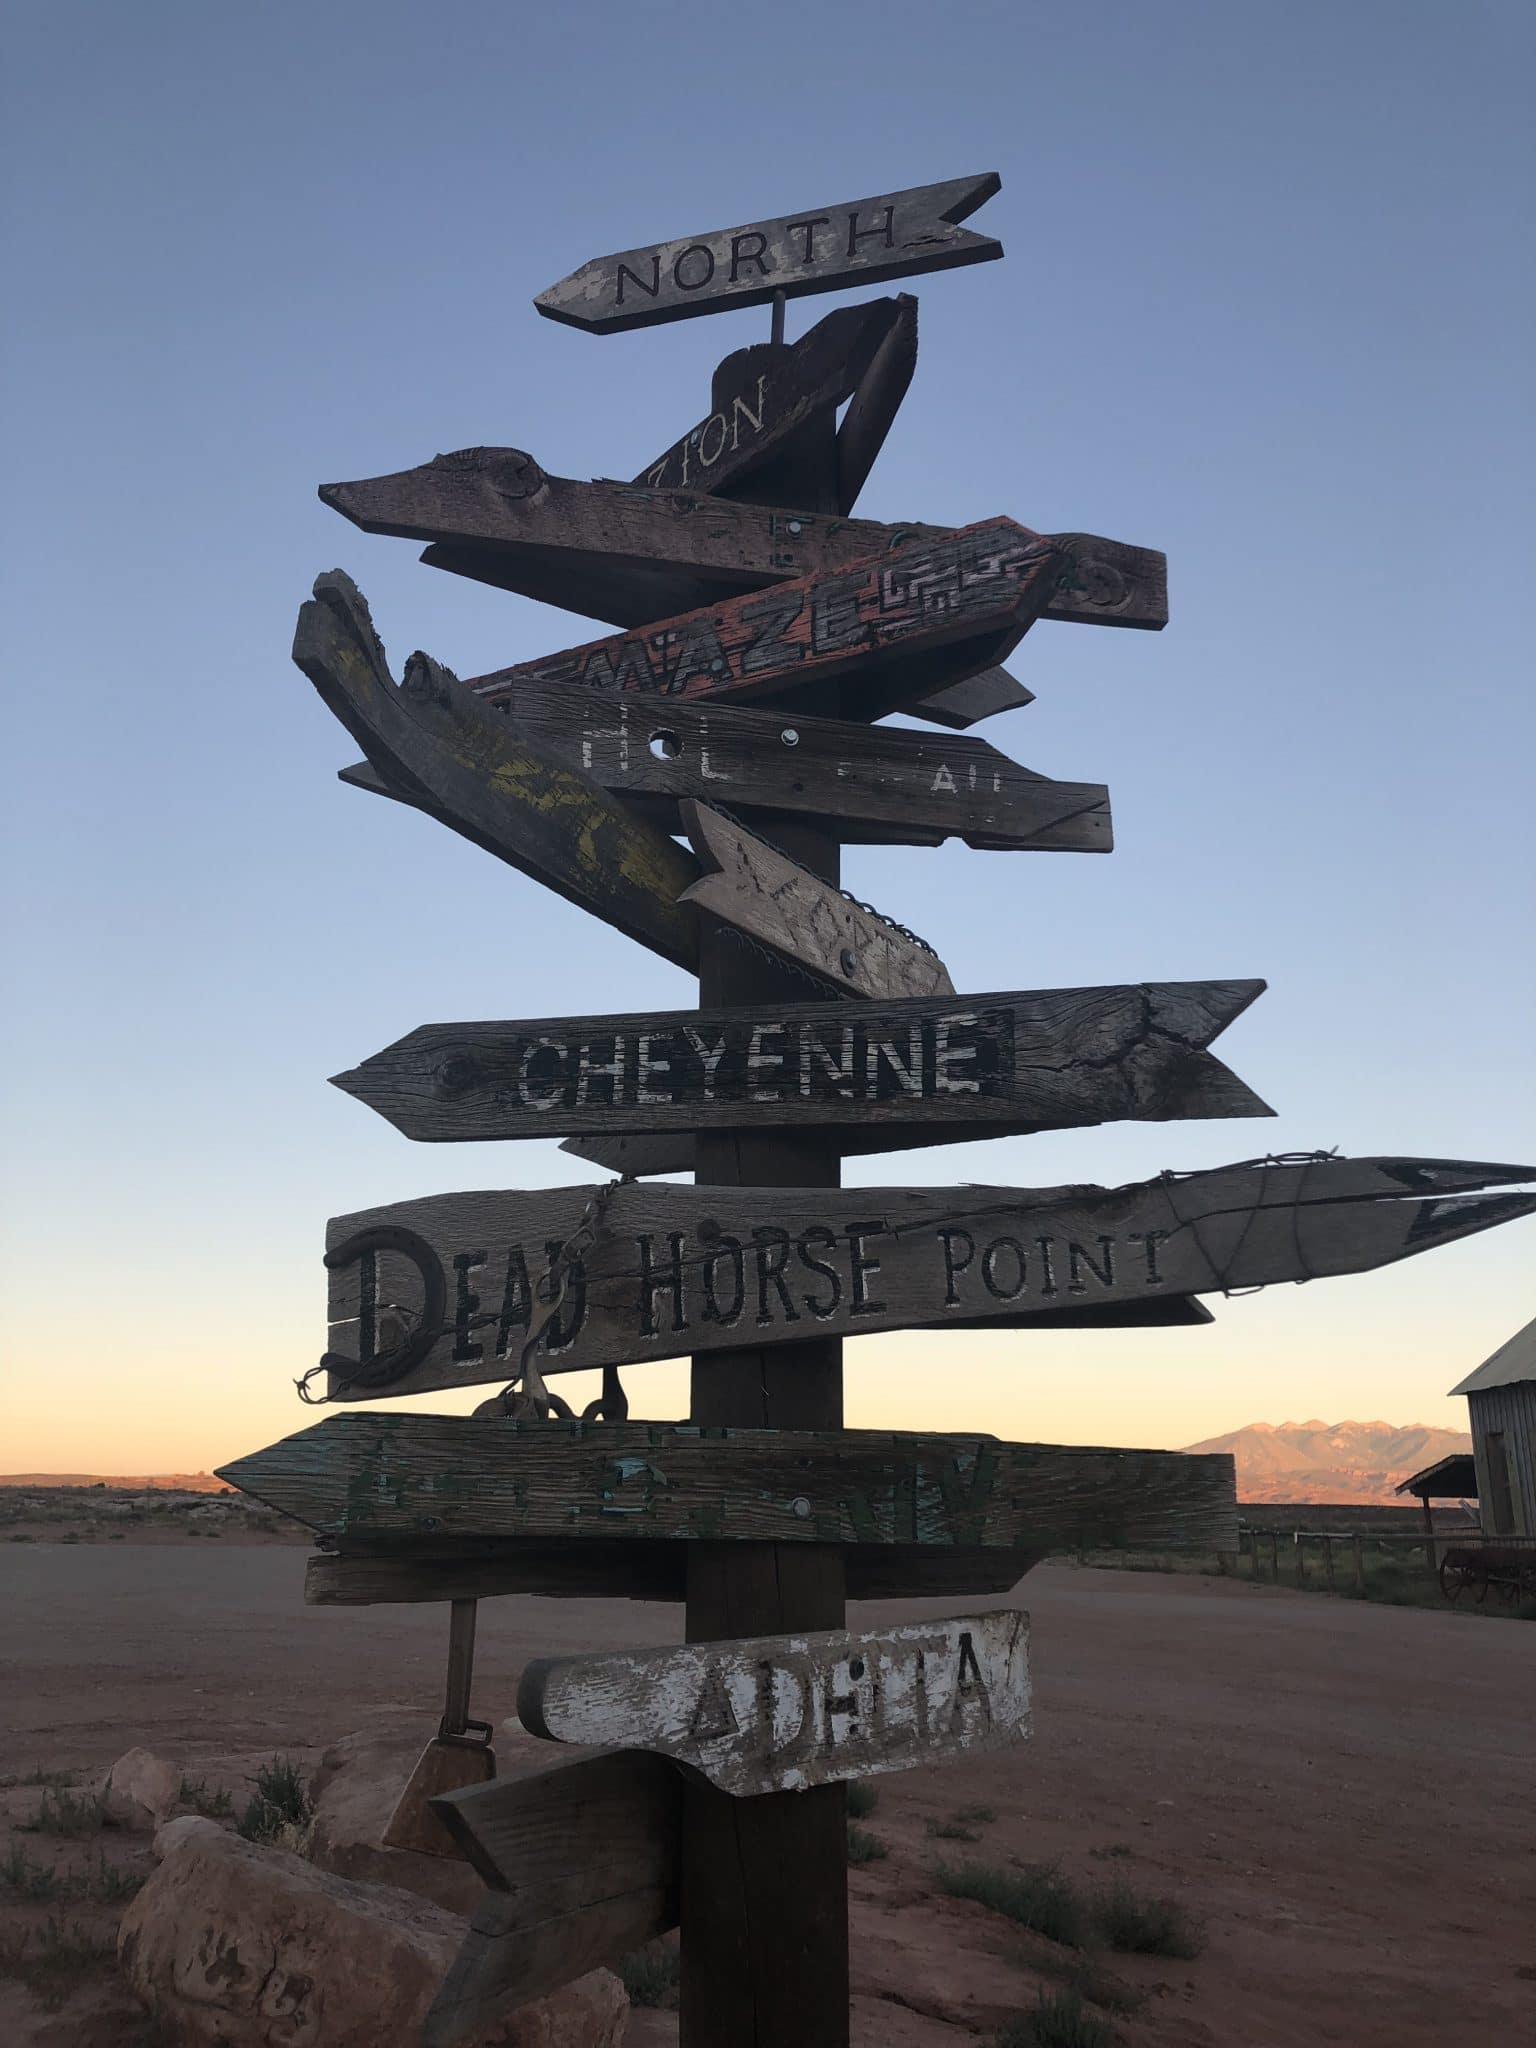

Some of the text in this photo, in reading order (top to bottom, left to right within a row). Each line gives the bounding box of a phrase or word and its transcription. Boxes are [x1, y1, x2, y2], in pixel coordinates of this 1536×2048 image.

[615, 204, 896, 305] NORTH
[518, 1012, 981, 1110] CHEYENNE
[325, 1220, 1170, 1388] DEAD HORSE POINT
